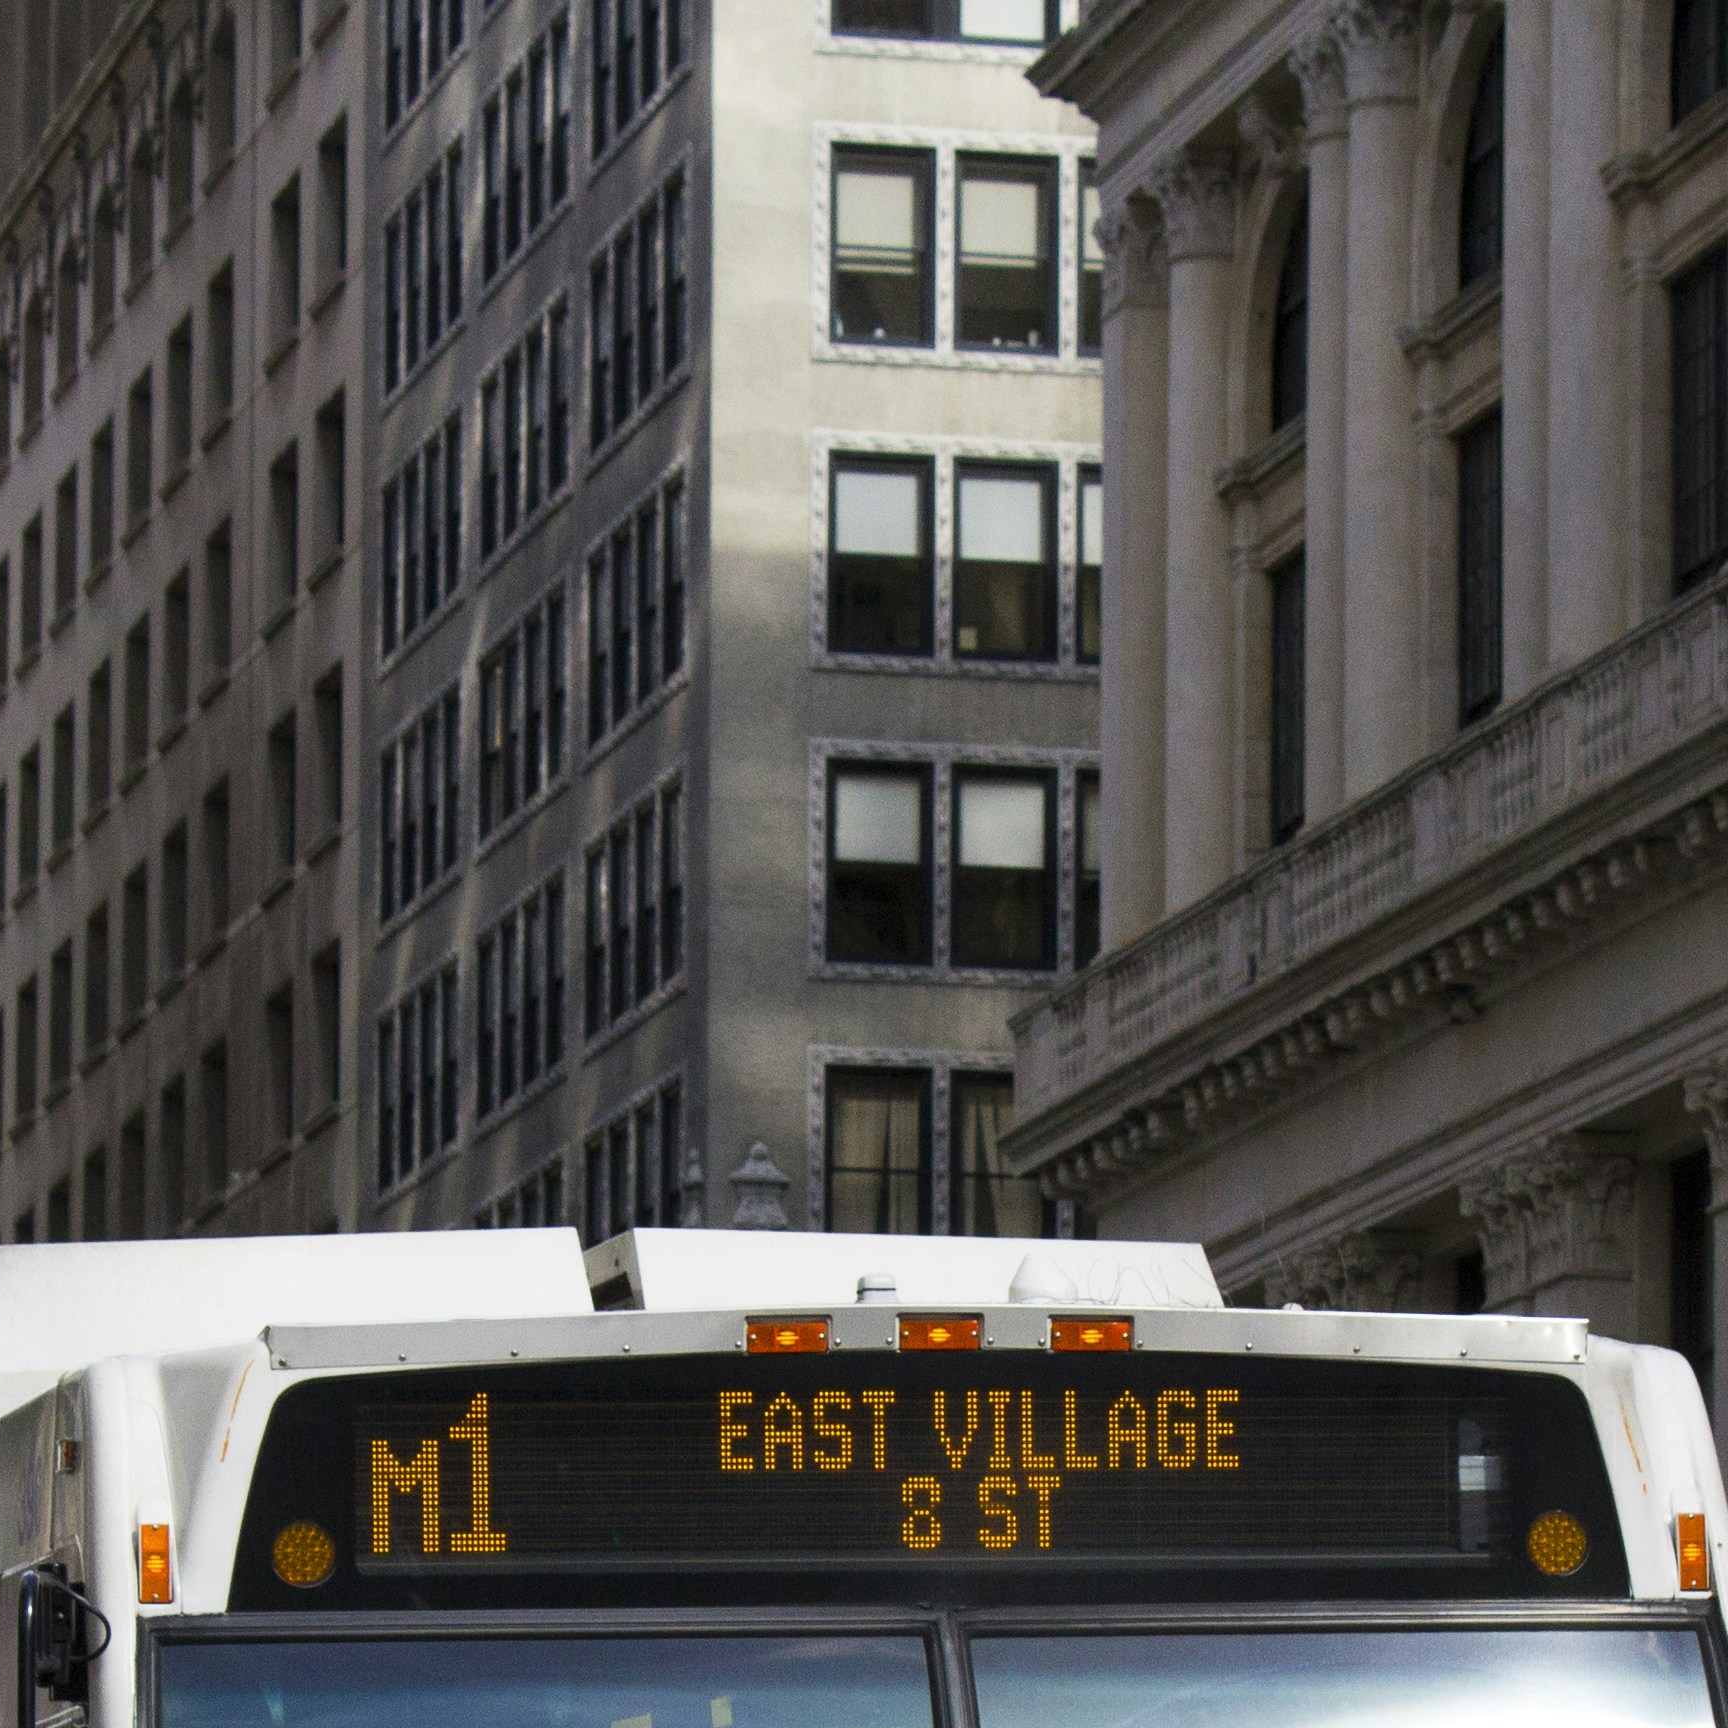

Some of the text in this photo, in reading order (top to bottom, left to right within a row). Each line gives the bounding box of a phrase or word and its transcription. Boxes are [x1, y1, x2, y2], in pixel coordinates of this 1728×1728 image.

[719, 1389, 1240, 1470] EAST VILLAGE
[371, 1394, 507, 1553] M1
[903, 1476, 1060, 1550] 8 ST
